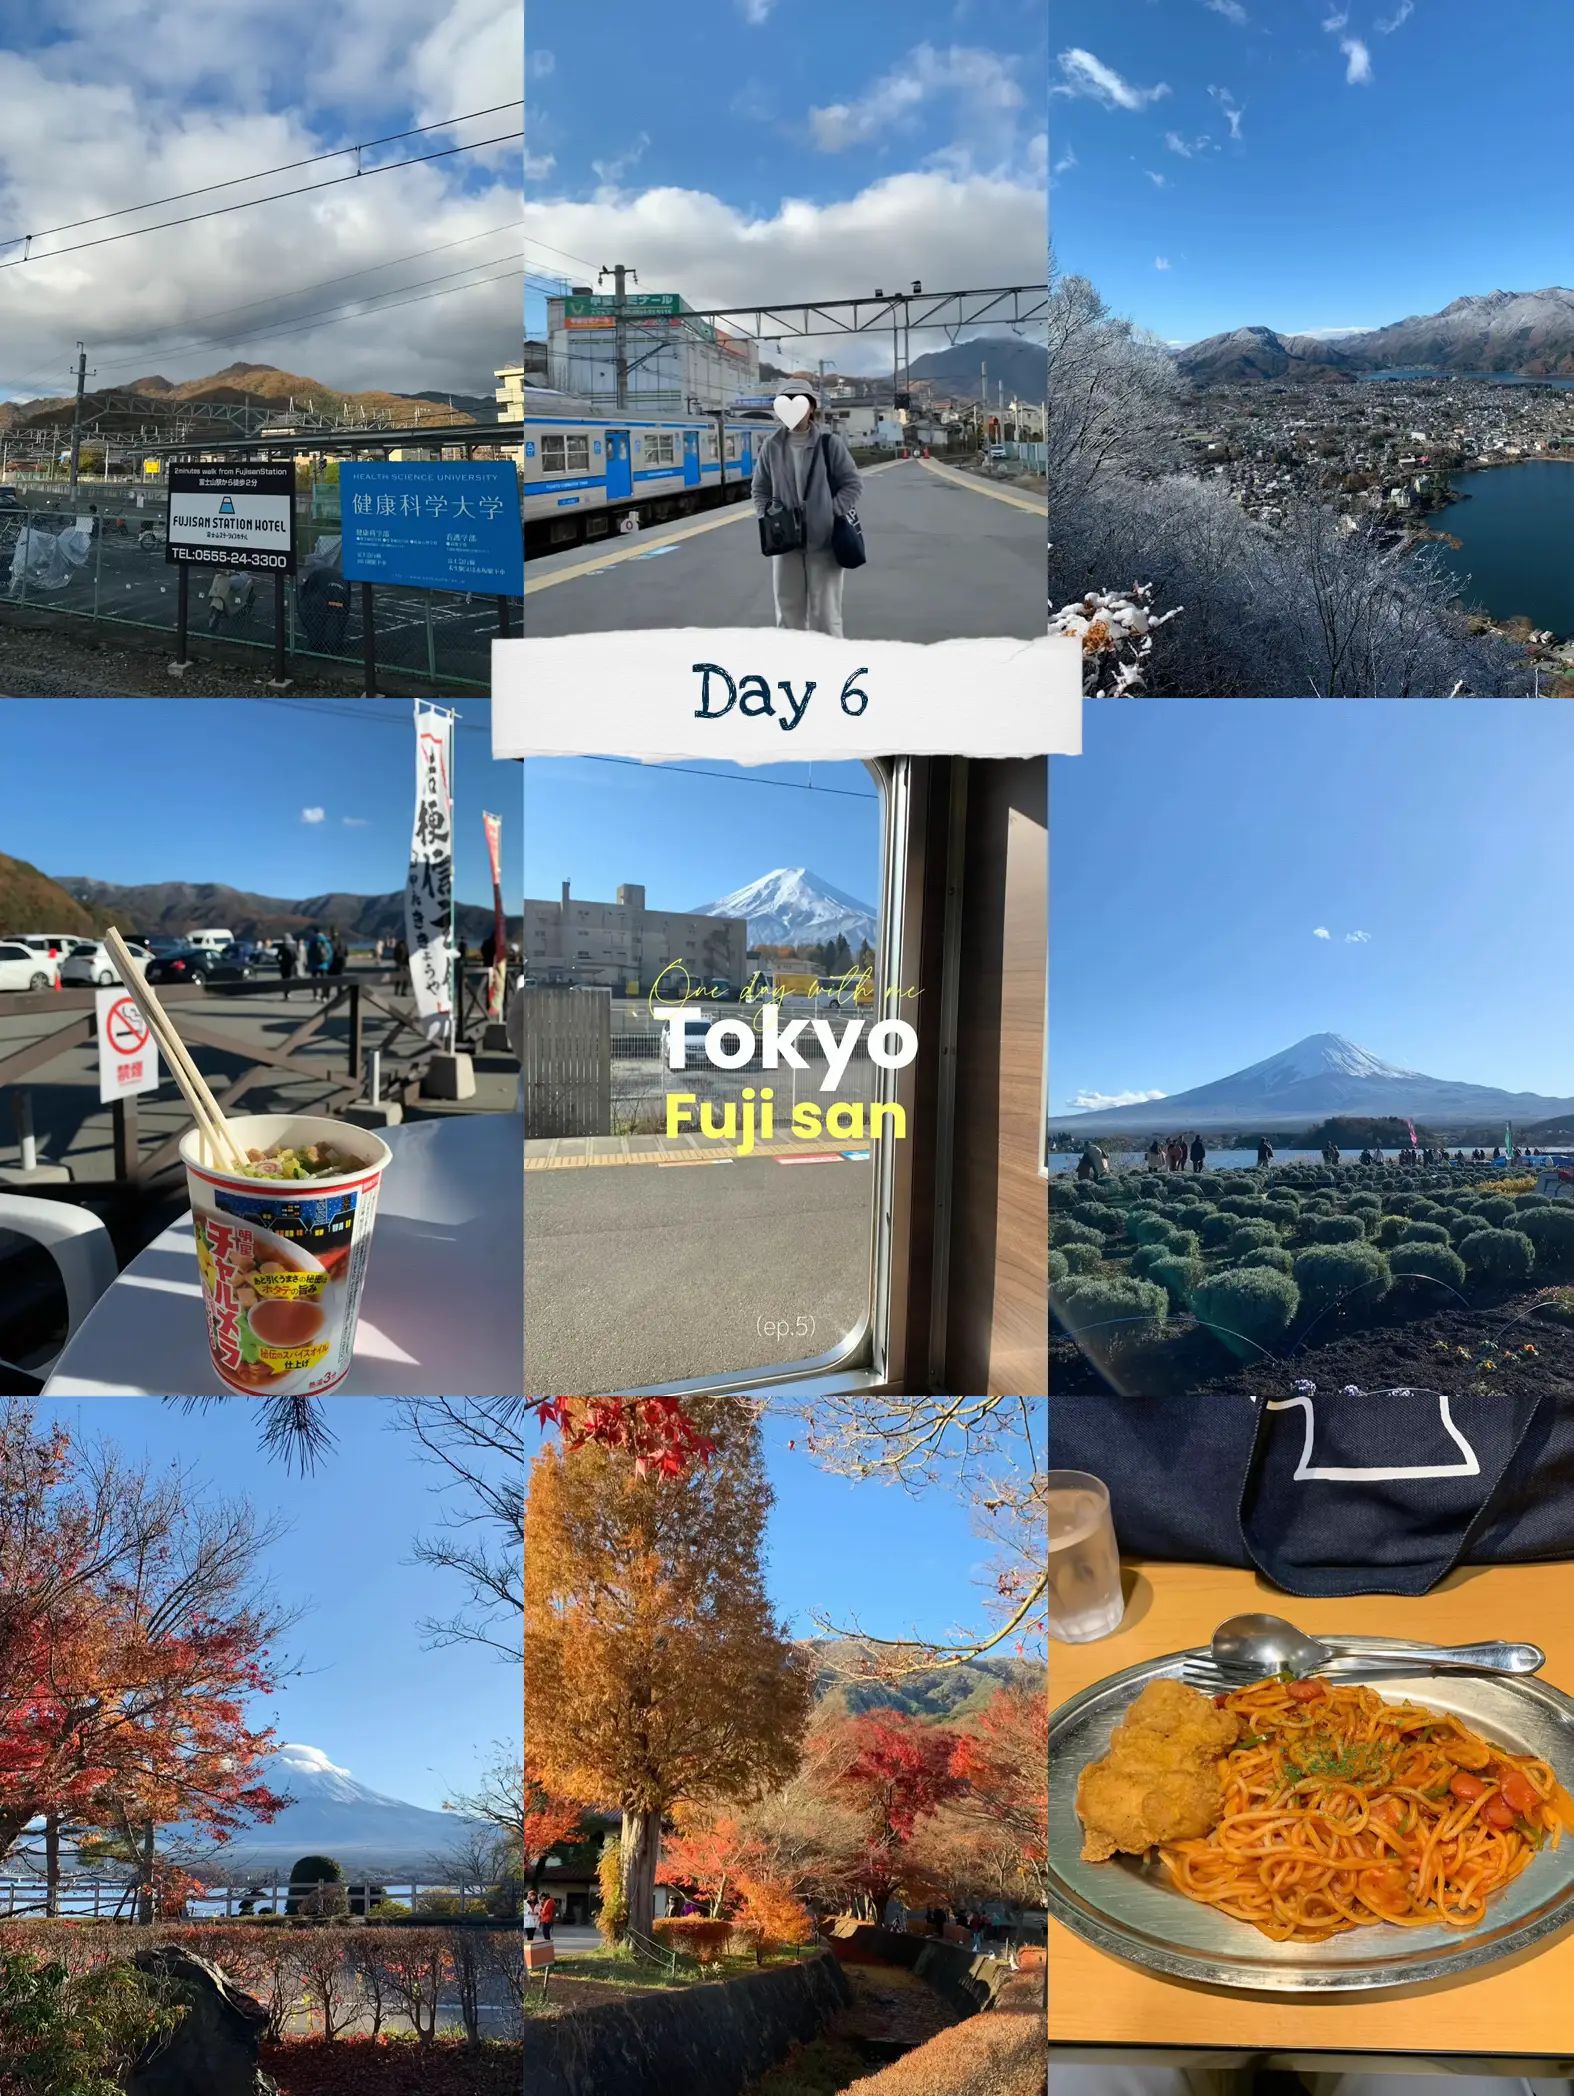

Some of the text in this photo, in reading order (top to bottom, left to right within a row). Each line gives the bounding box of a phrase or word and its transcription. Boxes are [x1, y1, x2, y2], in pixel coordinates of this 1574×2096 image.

[174, 467, 201, 475] 2minutes
[202, 467, 217, 475] walk
[235, 468, 287, 476] FujisanStation
[391, 474, 434, 482] SCIENCE
[437, 474, 498, 482] UNIVERSITY
[352, 493, 504, 520] 健康科学大学
[173, 516, 286, 532] FUJISAN STATION HOTEL
[172, 548, 287, 568] TEL:0555-24-3300
[205, 1217, 243, 1371] チャルメラ
[262, 1284, 317, 1295] ホタテの旨み
[260, 1343, 329, 1360] 秘伝のスパイスオイル
[284, 1358, 310, 1369] 仕上げ
